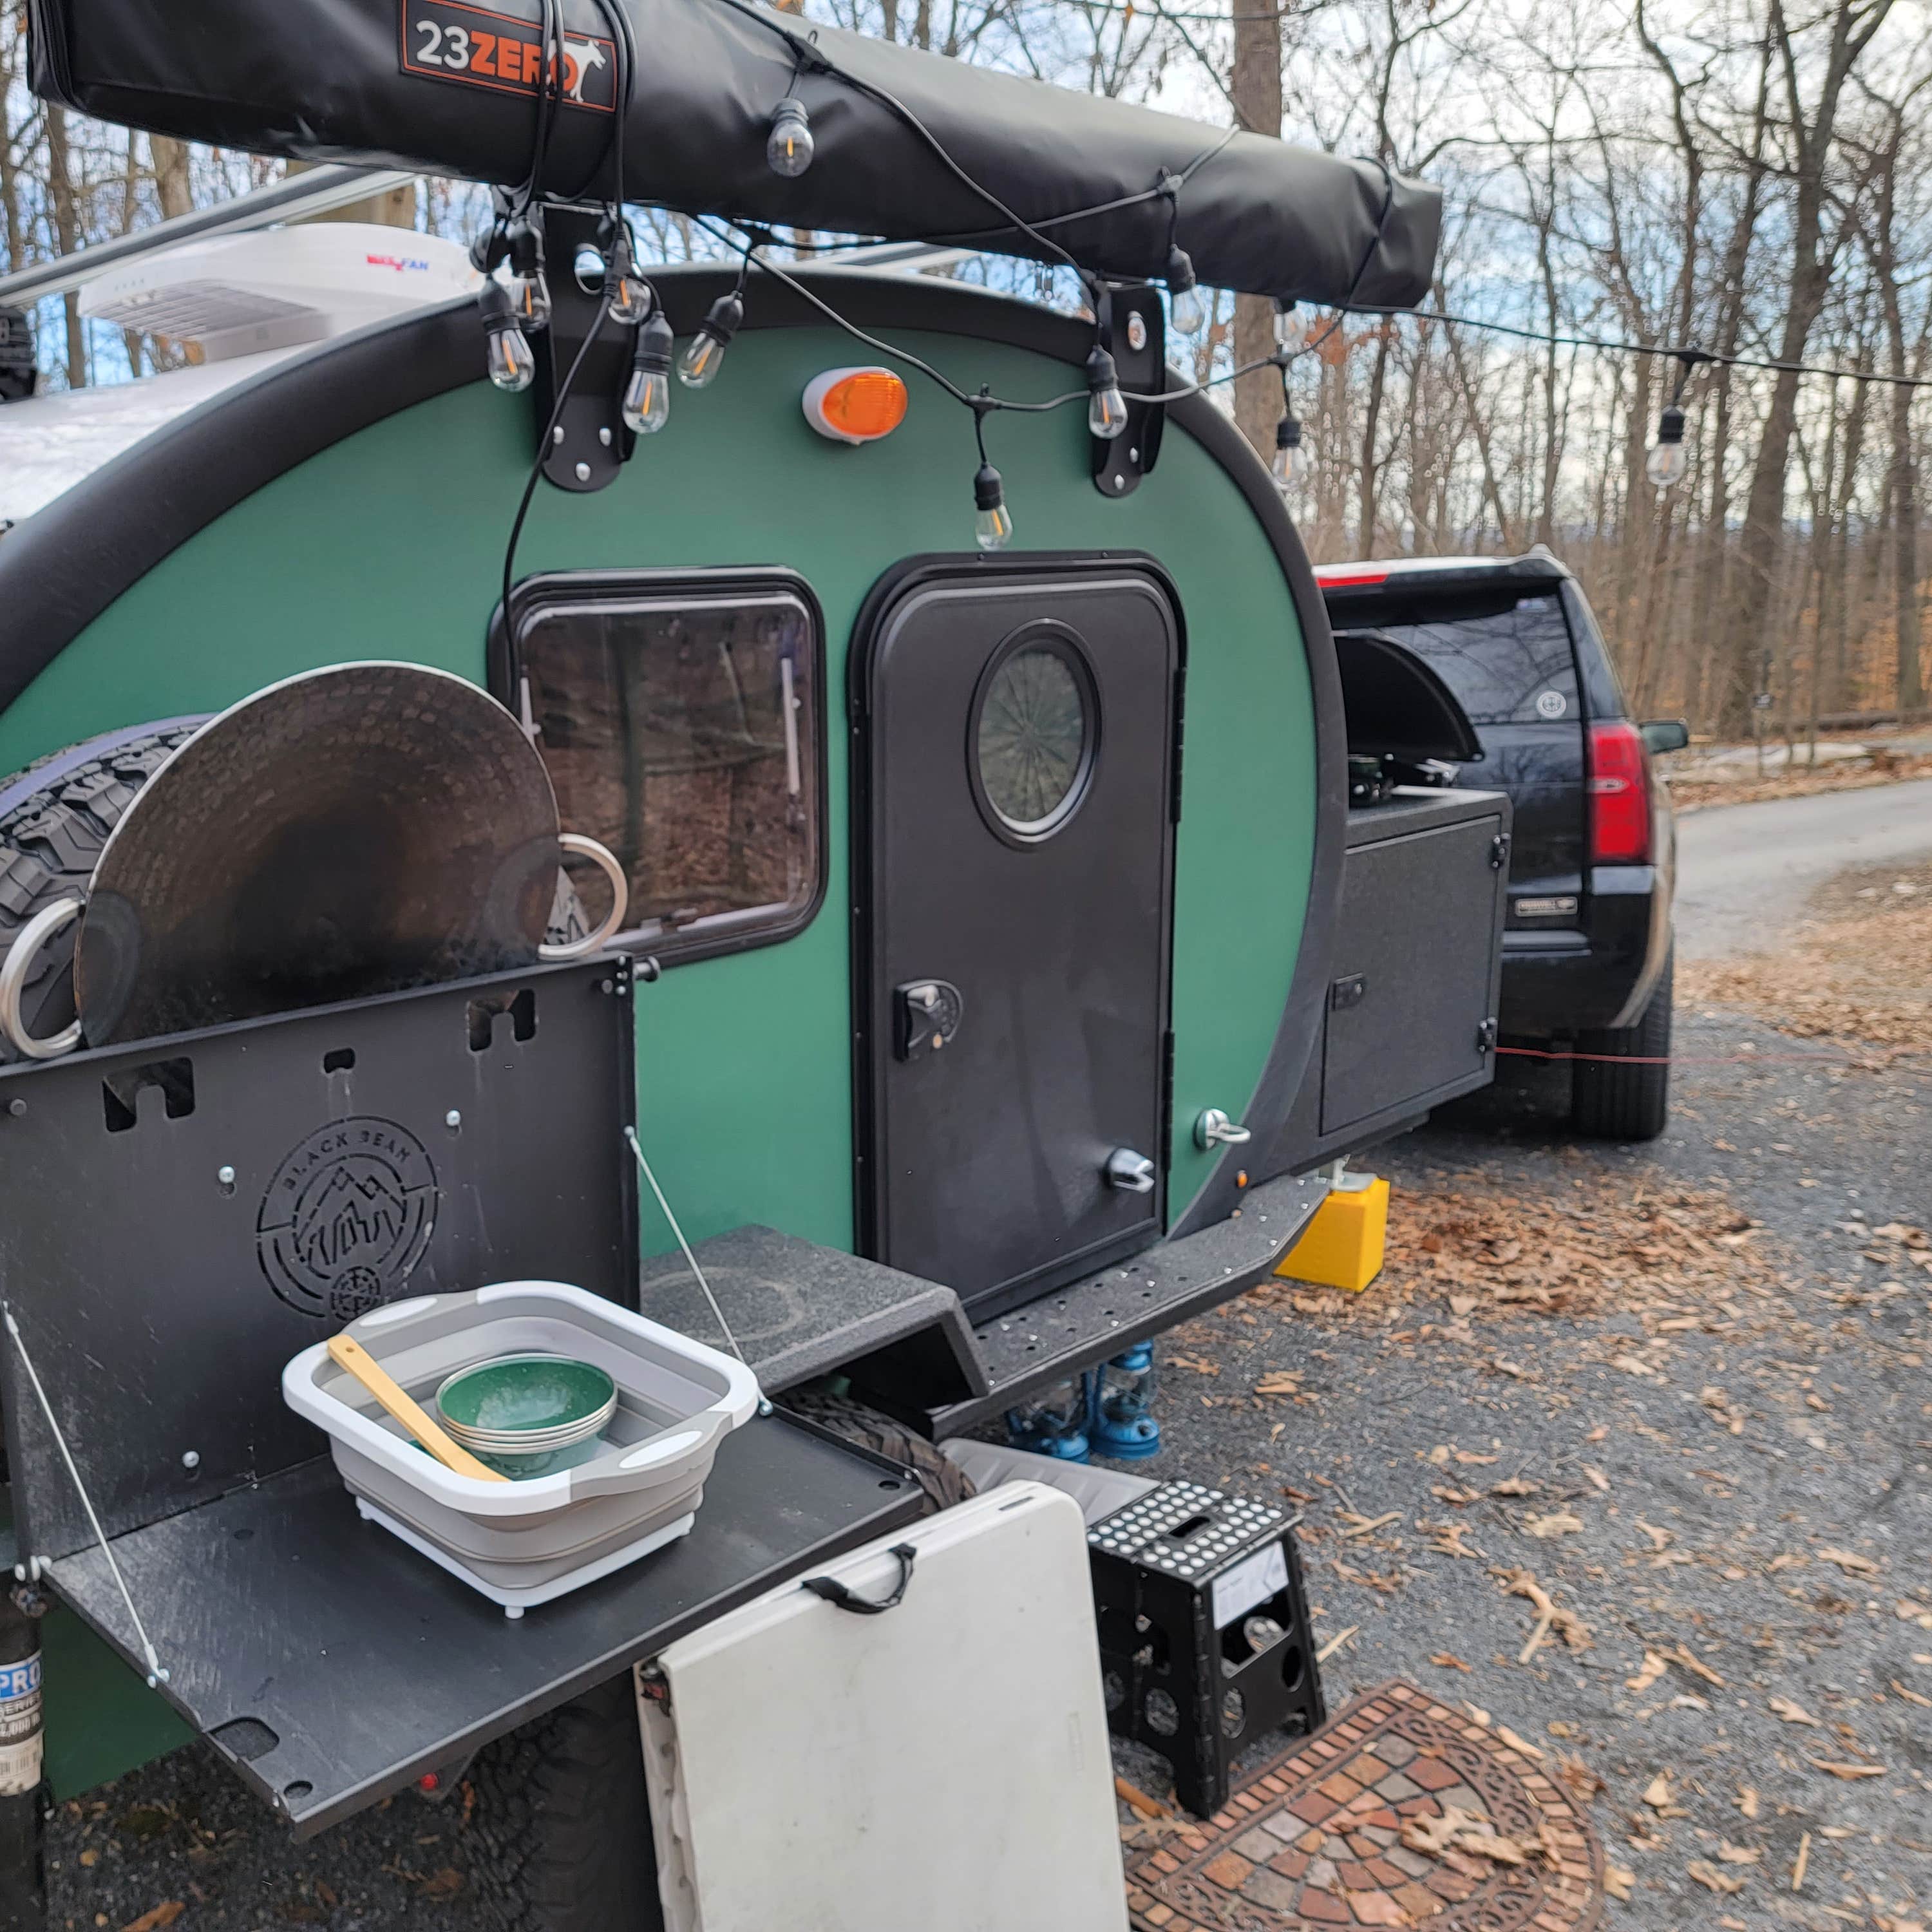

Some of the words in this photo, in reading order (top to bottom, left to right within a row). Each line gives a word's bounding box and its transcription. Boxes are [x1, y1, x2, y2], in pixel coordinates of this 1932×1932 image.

[416, 20, 578, 91] 23ZERO
[283, 1132, 348, 1190] BLACK
[0, 1660, 41, 1696] PRO
